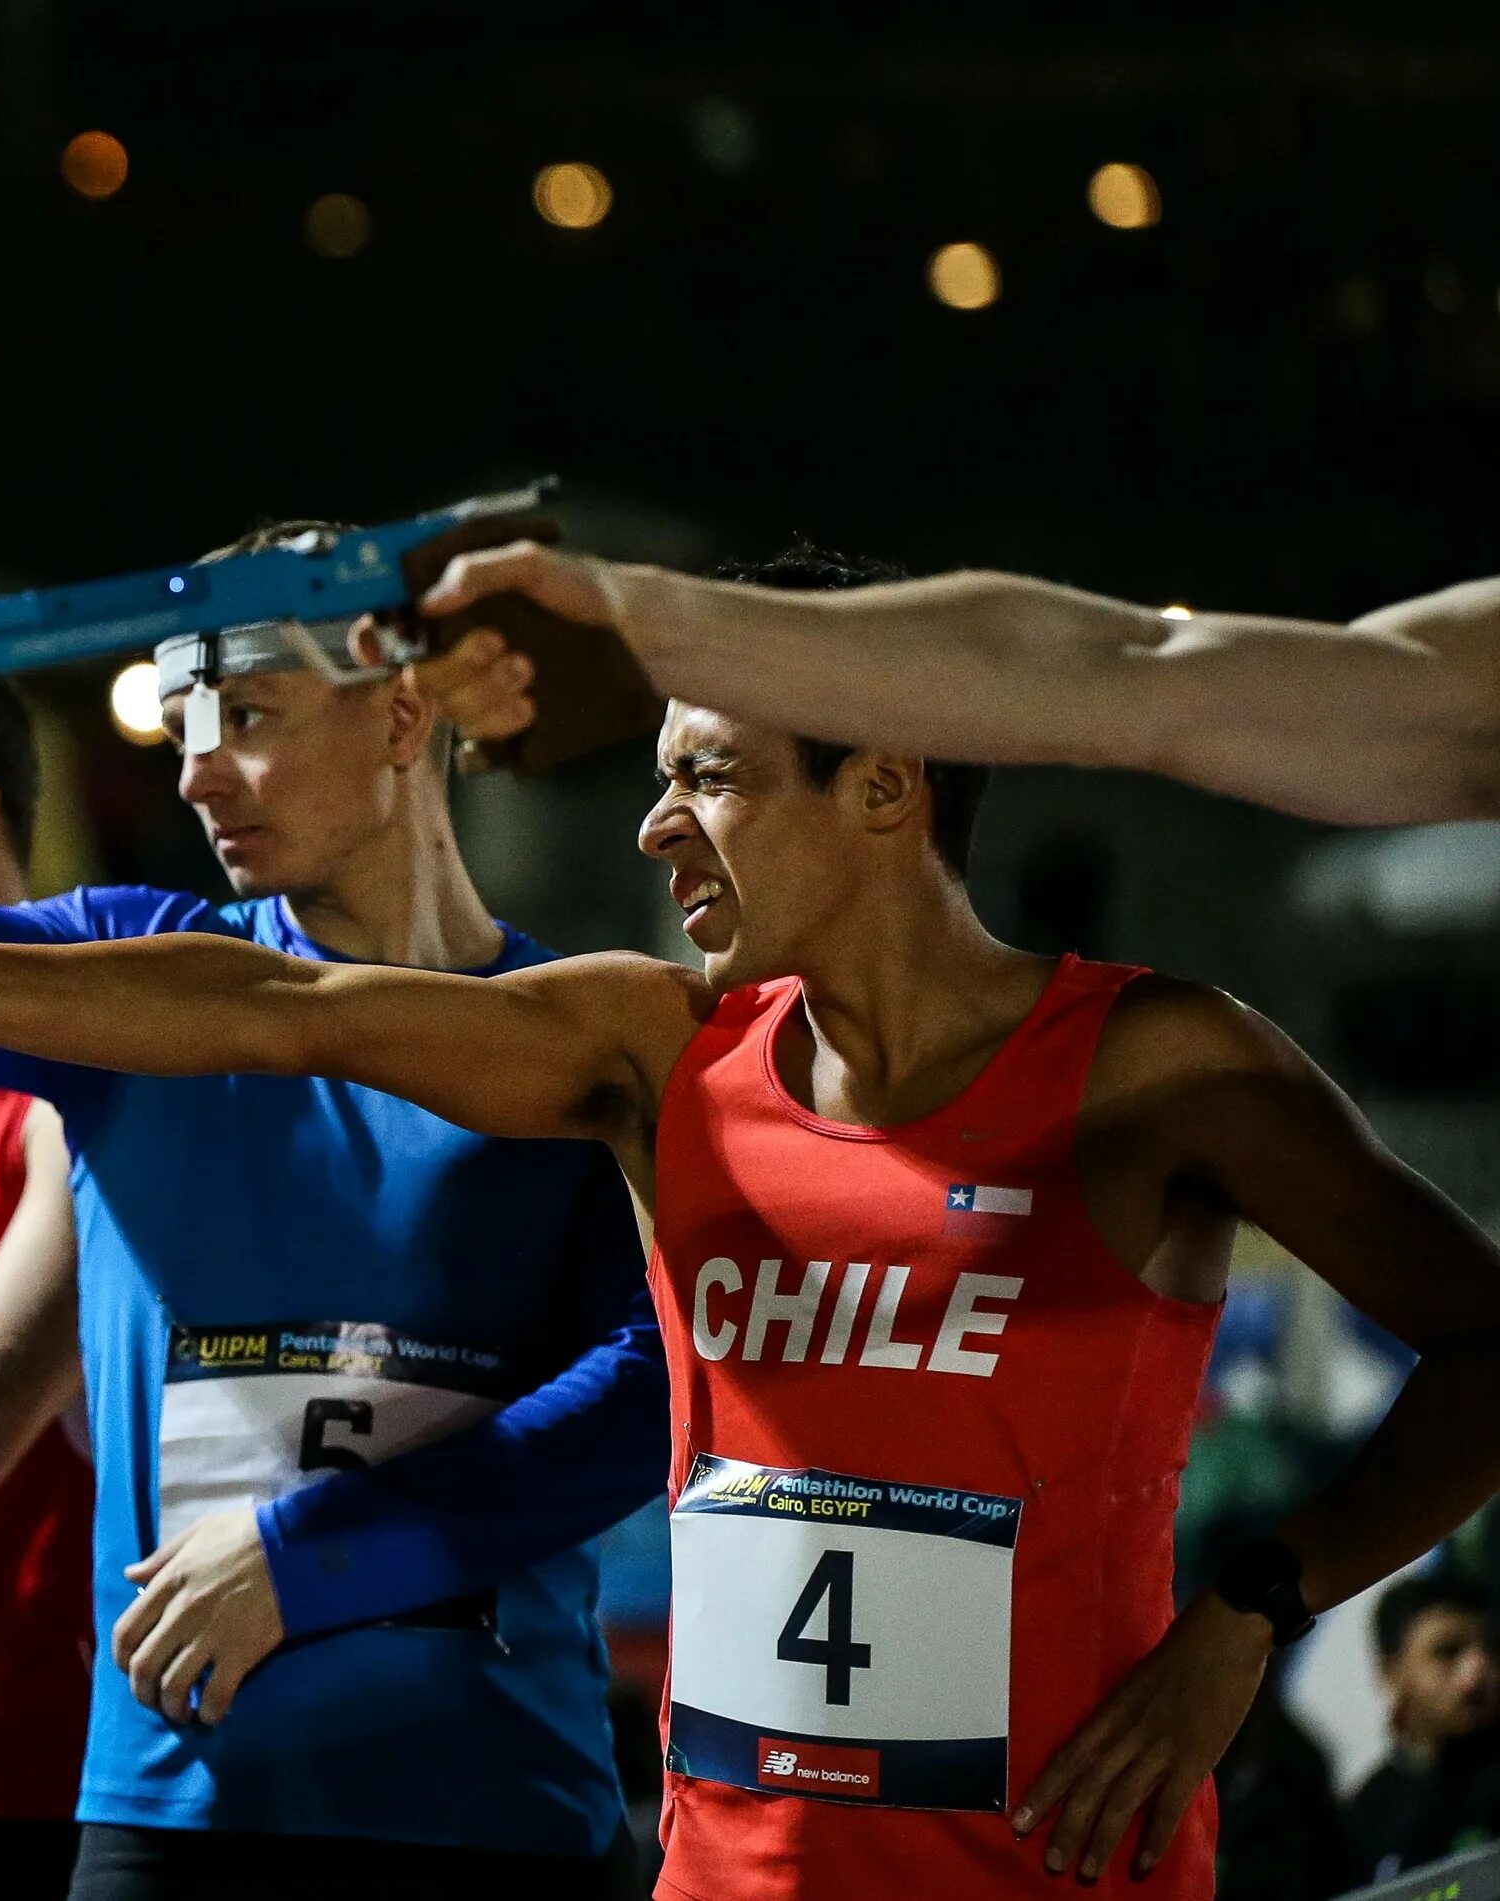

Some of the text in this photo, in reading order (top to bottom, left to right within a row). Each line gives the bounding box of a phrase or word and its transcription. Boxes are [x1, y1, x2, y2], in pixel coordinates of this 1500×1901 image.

[693, 1256, 1024, 1378] CHILE
[200, 1333, 268, 1360] UIPM
[767, 1493, 872, 1518] Cairo, EGYPT
[771, 1475, 1008, 1520] Pentathlon World Cup
[776, 1548, 872, 1707] 4
[797, 1768, 870, 1785] new balance
